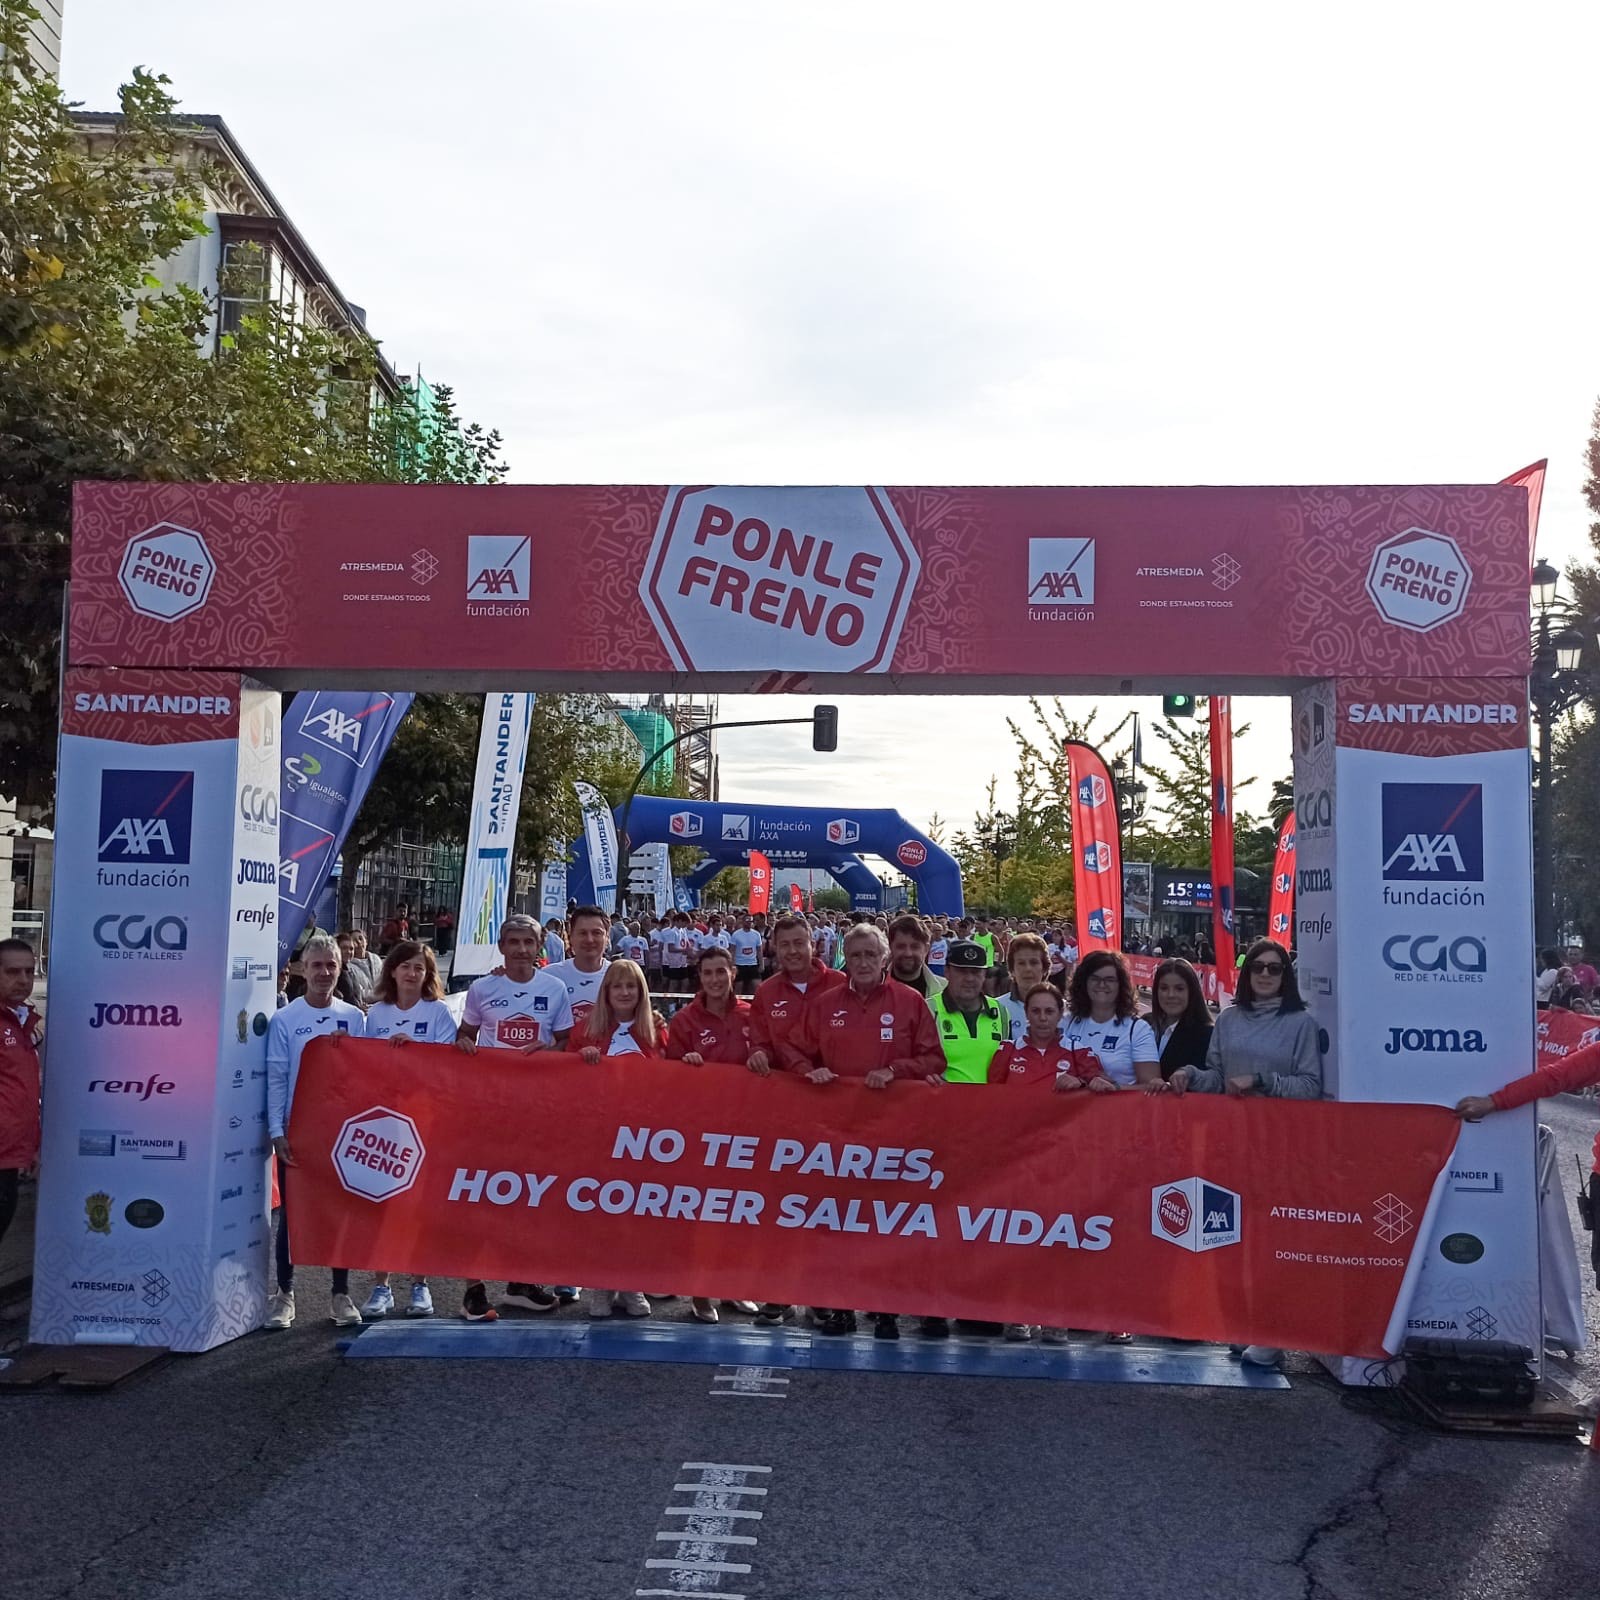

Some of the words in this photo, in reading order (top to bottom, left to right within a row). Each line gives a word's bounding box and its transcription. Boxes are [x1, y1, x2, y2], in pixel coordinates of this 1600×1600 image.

[694, 503, 883, 599] PONLE
[138, 546, 203, 580] PONLE
[340, 563, 404, 571] ATRESMEDIA
[1136, 567, 1204, 577] ATRESMEDIA
[1385, 553, 1458, 587] PONLE
[132, 565, 197, 596] FRENO
[467, 569, 519, 594] AXA
[1028, 572, 1083, 598] AXA
[1380, 573, 1453, 606] FRENO
[371, 594, 404, 602] ESTAMOS
[678, 556, 864, 646] FRENO
[1169, 600, 1205, 608] ESTAMOS
[466, 604, 530, 617] fundación
[1028, 608, 1095, 621] fundación
[74, 693, 231, 716] SANTANDER
[1348, 704, 1517, 724] SANTANDER
[304, 708, 363, 753] AXA
[488, 693, 514, 836] SANTANDER
[722, 828, 744, 839] AXA
[760, 820, 811, 831] fundación
[98, 818, 175, 856] AXA
[760, 832, 779, 840] AXA
[1382, 833, 1466, 872] AXA
[97, 867, 190, 888] fundación
[1383, 886, 1485, 906] fundación
[236, 904, 275, 931] renfe
[1299, 912, 1332, 941] renfe
[103, 951, 120, 959] RED
[123, 951, 134, 960] DE
[138, 951, 183, 960] TALLERES
[1394, 973, 1413, 982] RED
[1416, 973, 1429, 982] DE
[1433, 973, 1484, 983] TALLERES
[503, 1027, 534, 1040] 1083
[1544, 1041, 1569, 1056] VIDAS
[88, 1073, 176, 1101] renfe
[120, 1139, 174, 1148] SANTANDER
[351, 1128, 413, 1163] PONLE
[344, 1145, 406, 1179] FRENO
[611, 1126, 685, 1163] NO
[701, 1132, 760, 1170] TE
[769, 1138, 945, 1190] PARES,
[1450, 1171, 1488, 1180] TANDER
[447, 1168, 558, 1207] HOY
[566, 1176, 765, 1225] CORRER
[775, 1193, 938, 1238] SALVA
[957, 1205, 1114, 1251] VIDAS
[1160, 1207, 1185, 1226] FRENO
[1162, 1198, 1187, 1218] PONLE
[1270, 1206, 1363, 1224] ATRESMEDIA
[1203, 1211, 1229, 1229] AXA
[1203, 1234, 1235, 1246] fundación
[1275, 1250, 1313, 1263] DONDE
[1316, 1254, 1365, 1266] ESTAMOS
[1368, 1257, 1405, 1267] TODOS
[71, 1281, 136, 1292] ATRESMEDIA
[1407, 1319, 1459, 1330] ESMEDIA
